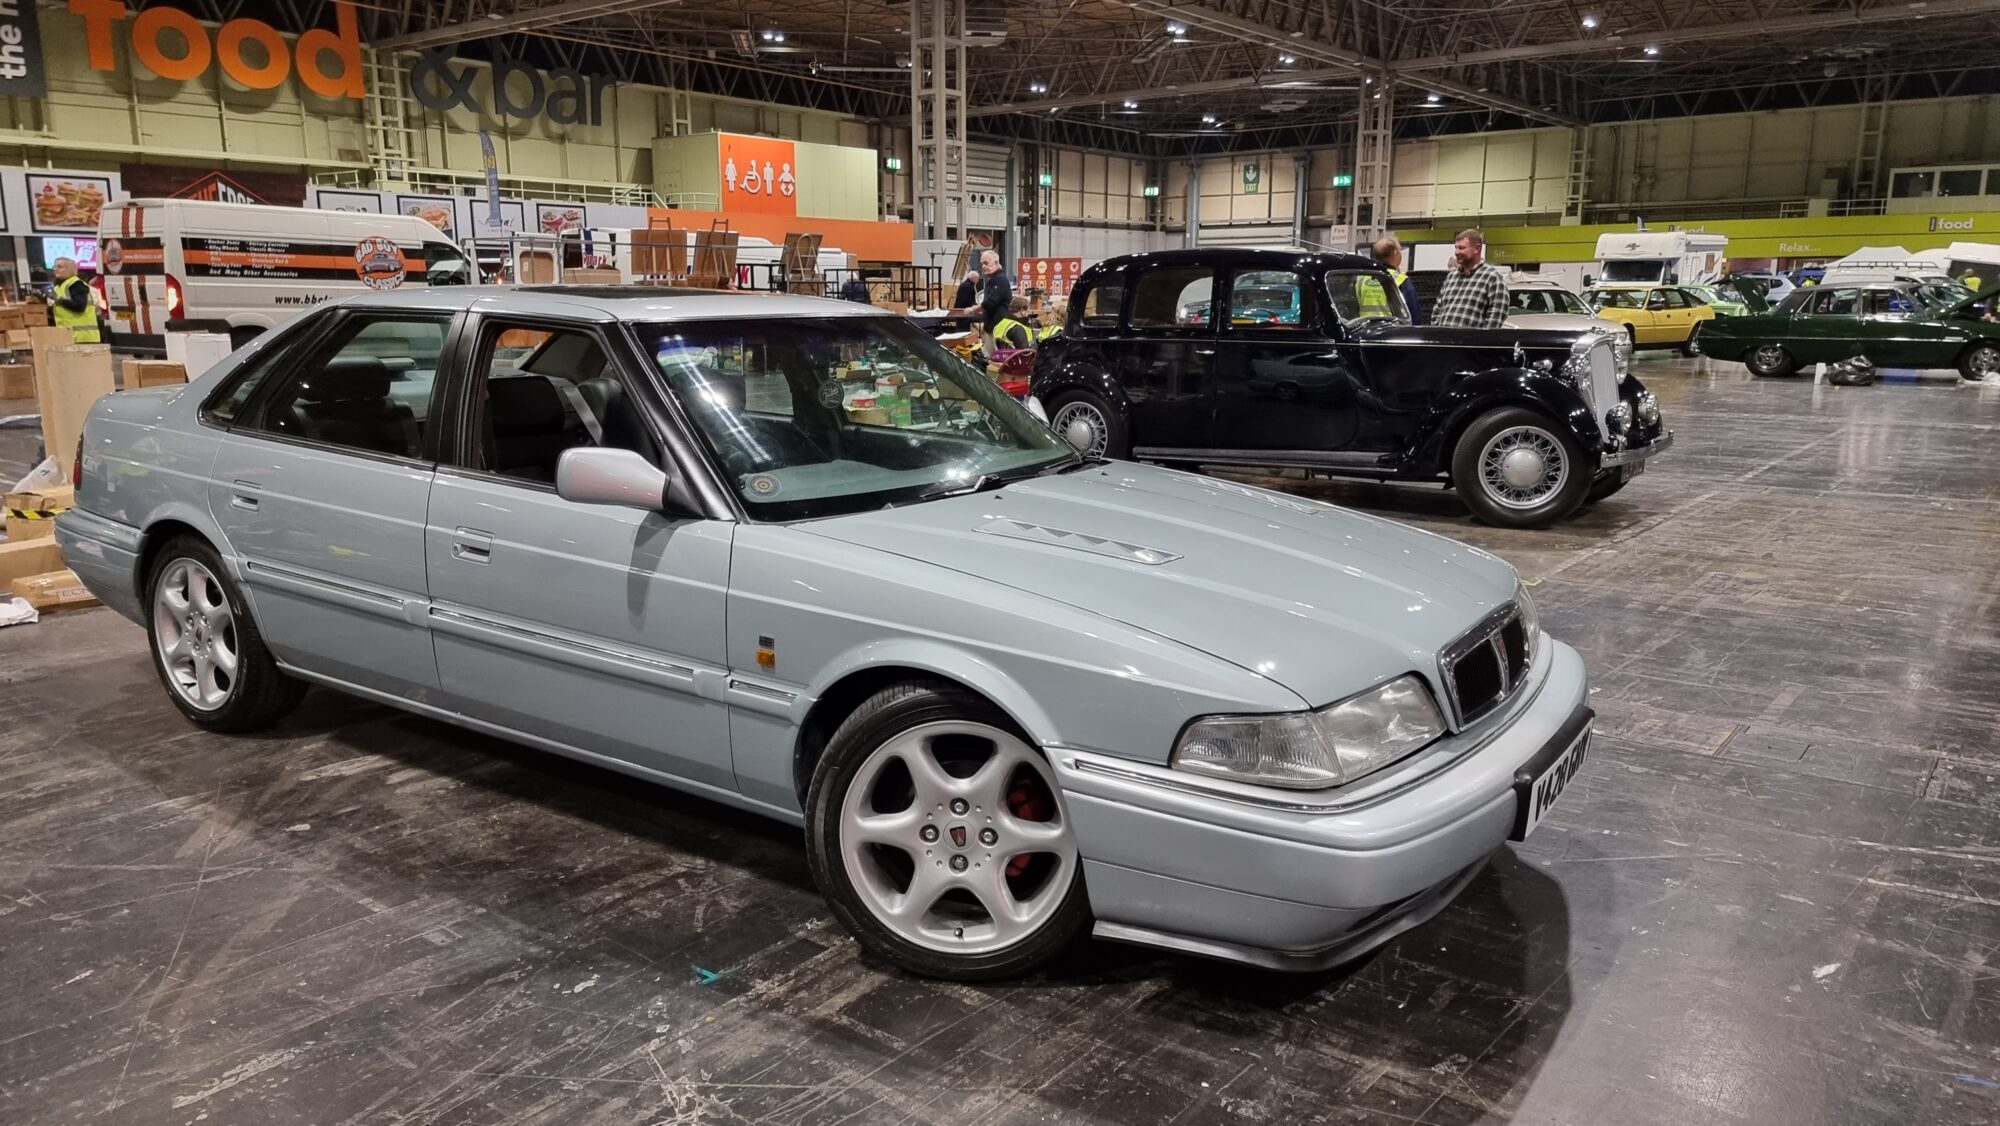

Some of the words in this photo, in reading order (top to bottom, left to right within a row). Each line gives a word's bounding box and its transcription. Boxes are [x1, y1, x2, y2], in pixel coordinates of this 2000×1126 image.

[0, 24, 27, 79] the
[67, 0, 365, 99] food
[490, 36, 623, 127] bar
[1938, 217, 1974, 230] food
[224, 269, 241, 277] Many
[263, 269, 298, 278] Accessories
[275, 294, 333, 304] www.bbcl
[1534, 755, 1569, 823] V428
